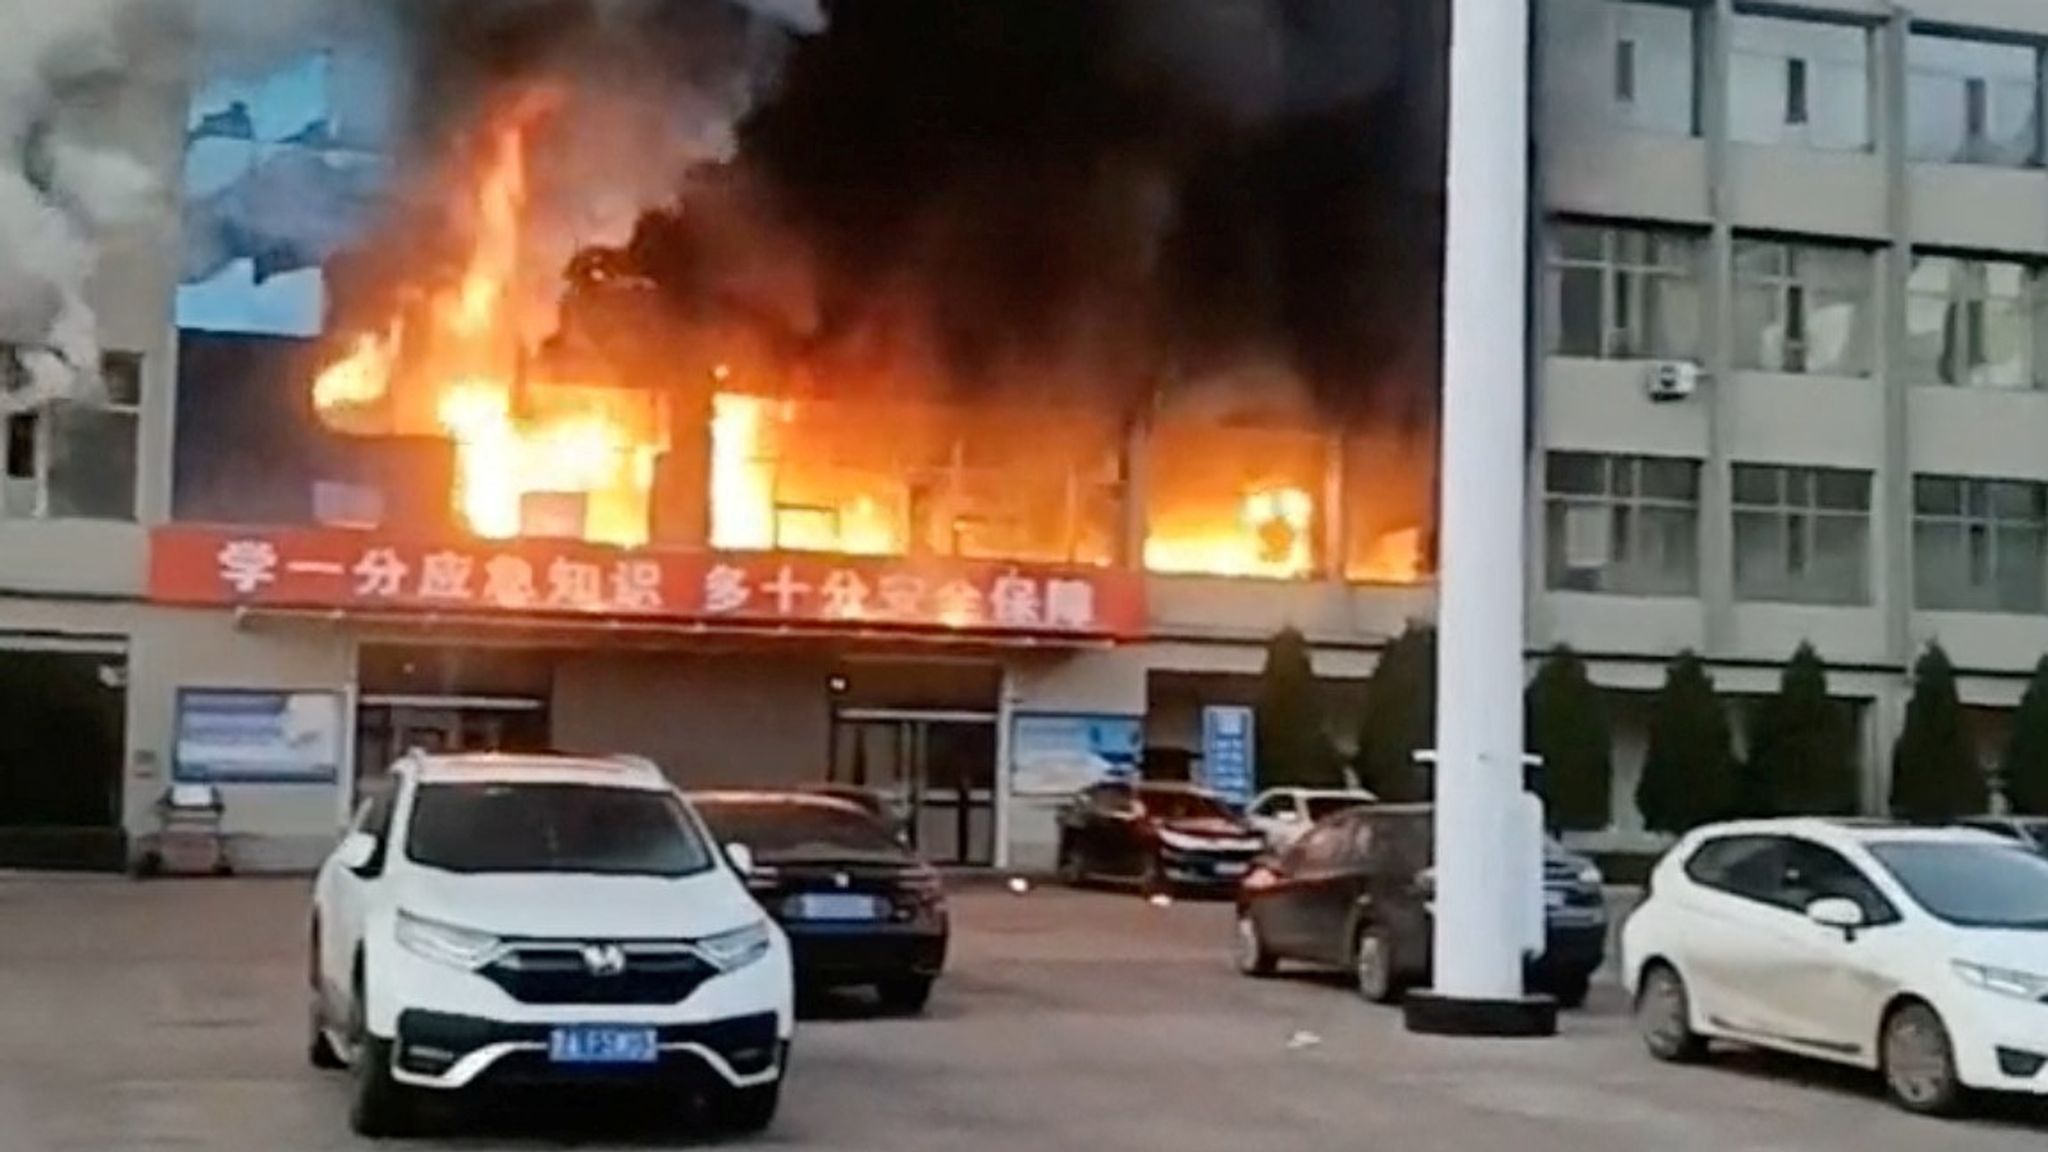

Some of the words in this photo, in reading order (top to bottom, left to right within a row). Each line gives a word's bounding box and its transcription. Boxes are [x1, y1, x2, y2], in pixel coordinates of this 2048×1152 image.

[217, 540, 663, 609] 学一分应急知识
